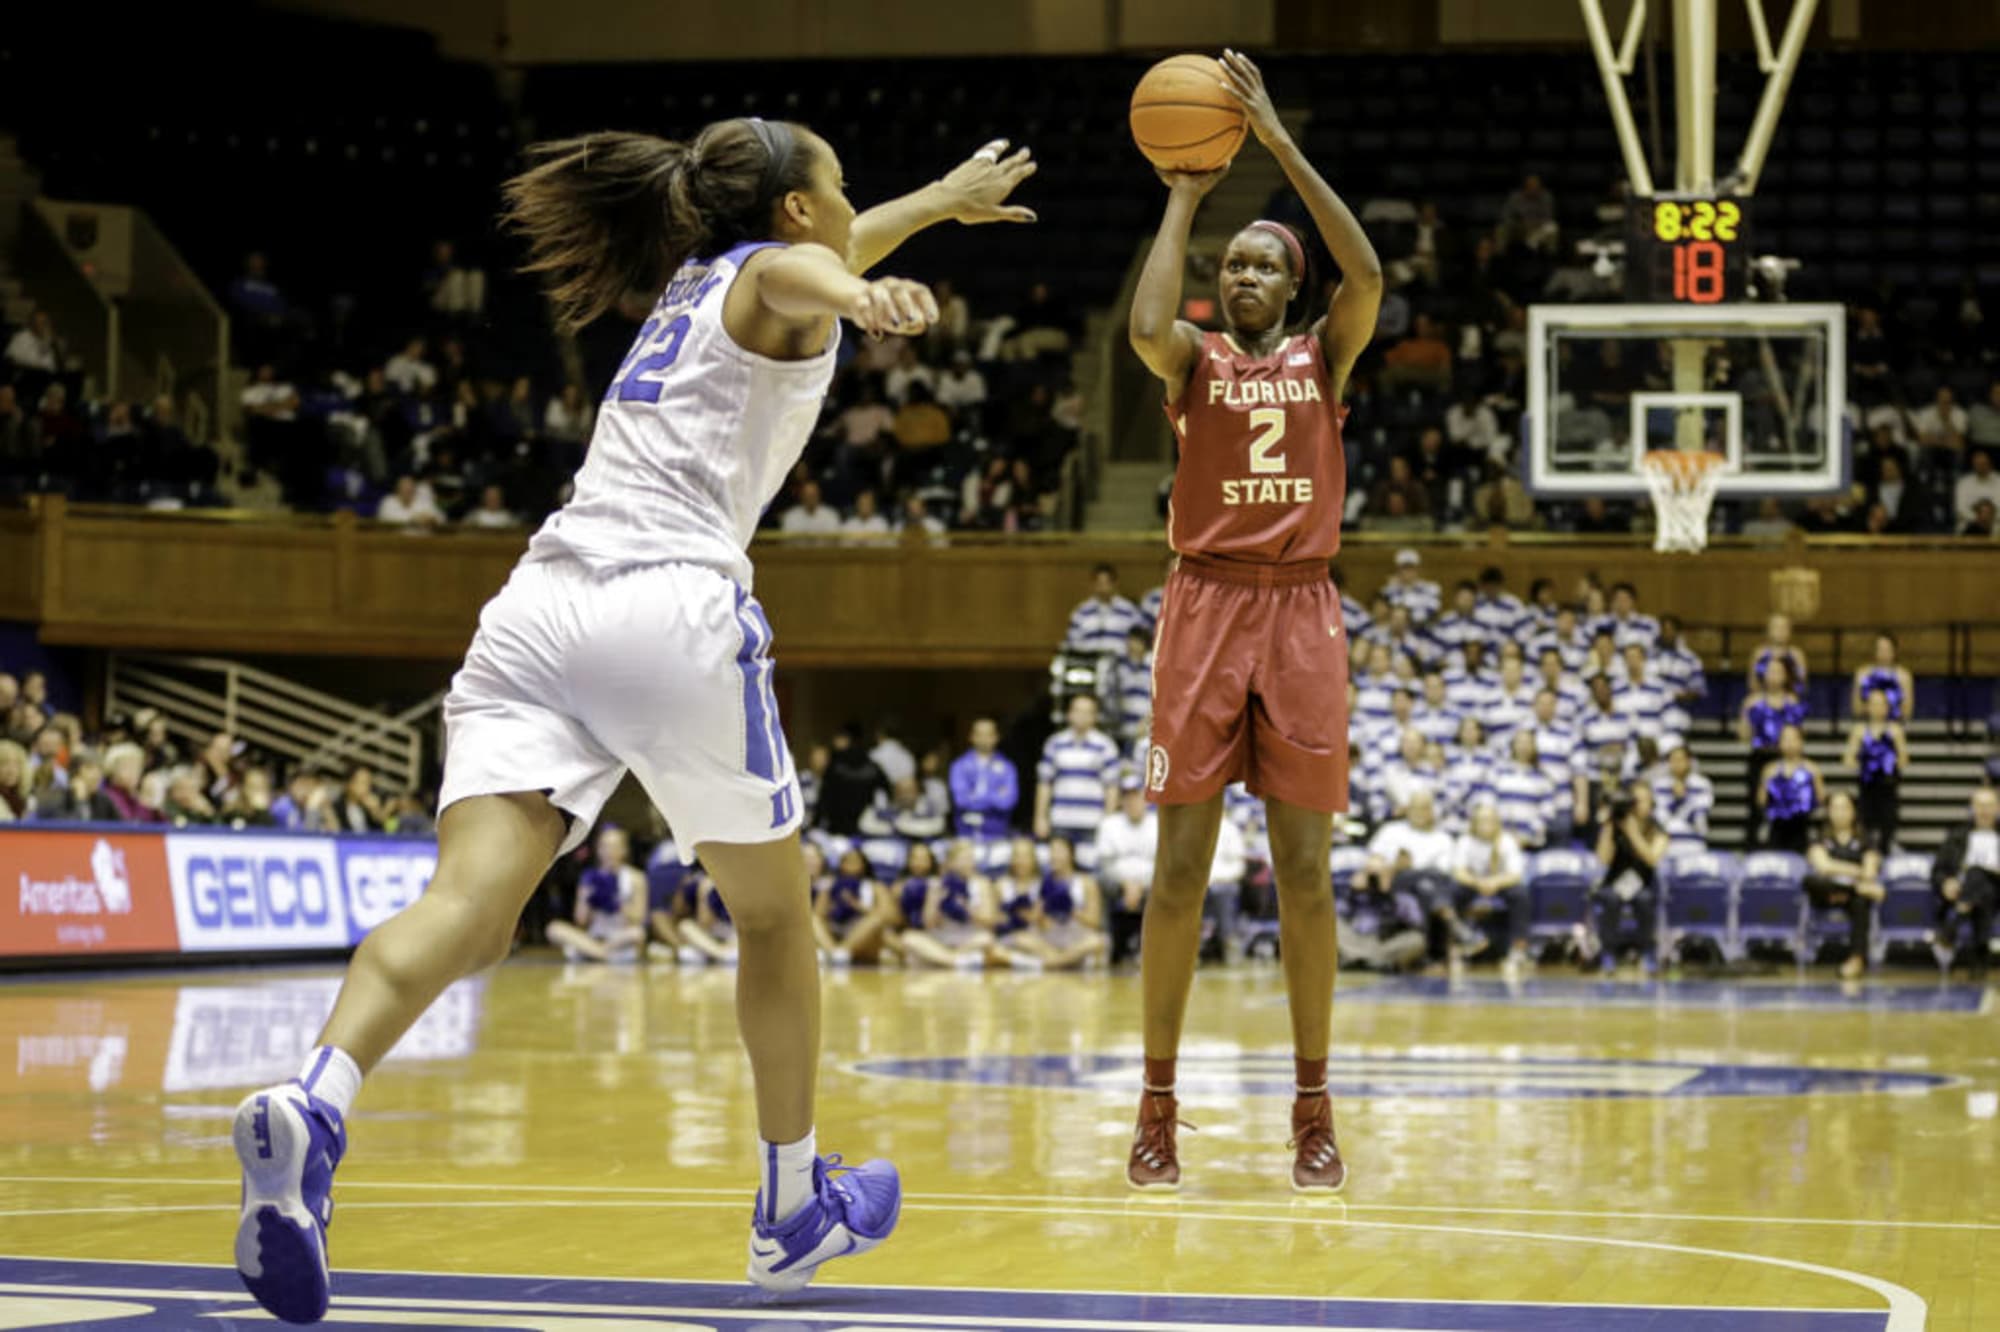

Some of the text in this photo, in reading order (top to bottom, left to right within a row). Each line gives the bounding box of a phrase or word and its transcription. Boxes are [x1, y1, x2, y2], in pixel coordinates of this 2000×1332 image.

[1655, 201, 1740, 242] 8:22
[1673, 241, 1725, 304] 18
[1208, 378, 1321, 406] FLORIDA
[1249, 408, 1287, 474] 2
[1222, 479, 1313, 506] STATE
[187, 856, 330, 929] GEICO
